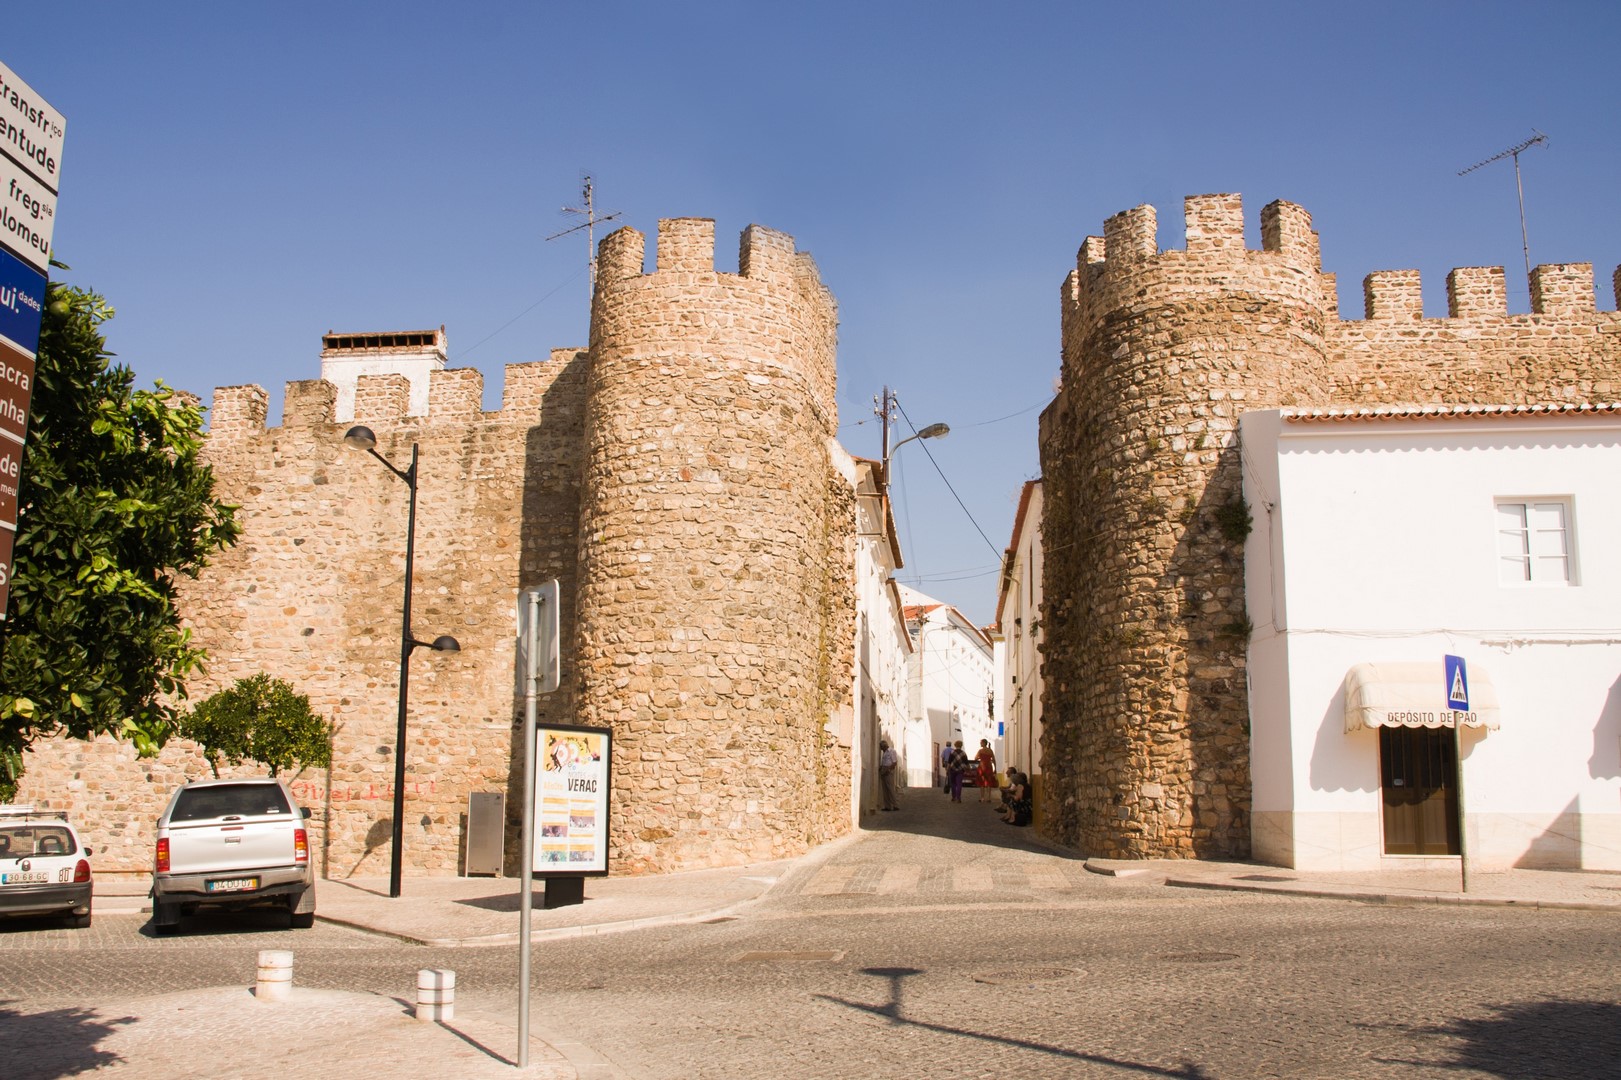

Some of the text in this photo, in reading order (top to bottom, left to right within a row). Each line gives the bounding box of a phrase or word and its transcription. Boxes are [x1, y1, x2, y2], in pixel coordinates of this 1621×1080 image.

[0, 206, 48, 255] lomeu
[0, 453, 18, 478] de
[1440, 712, 1452, 723] DE
